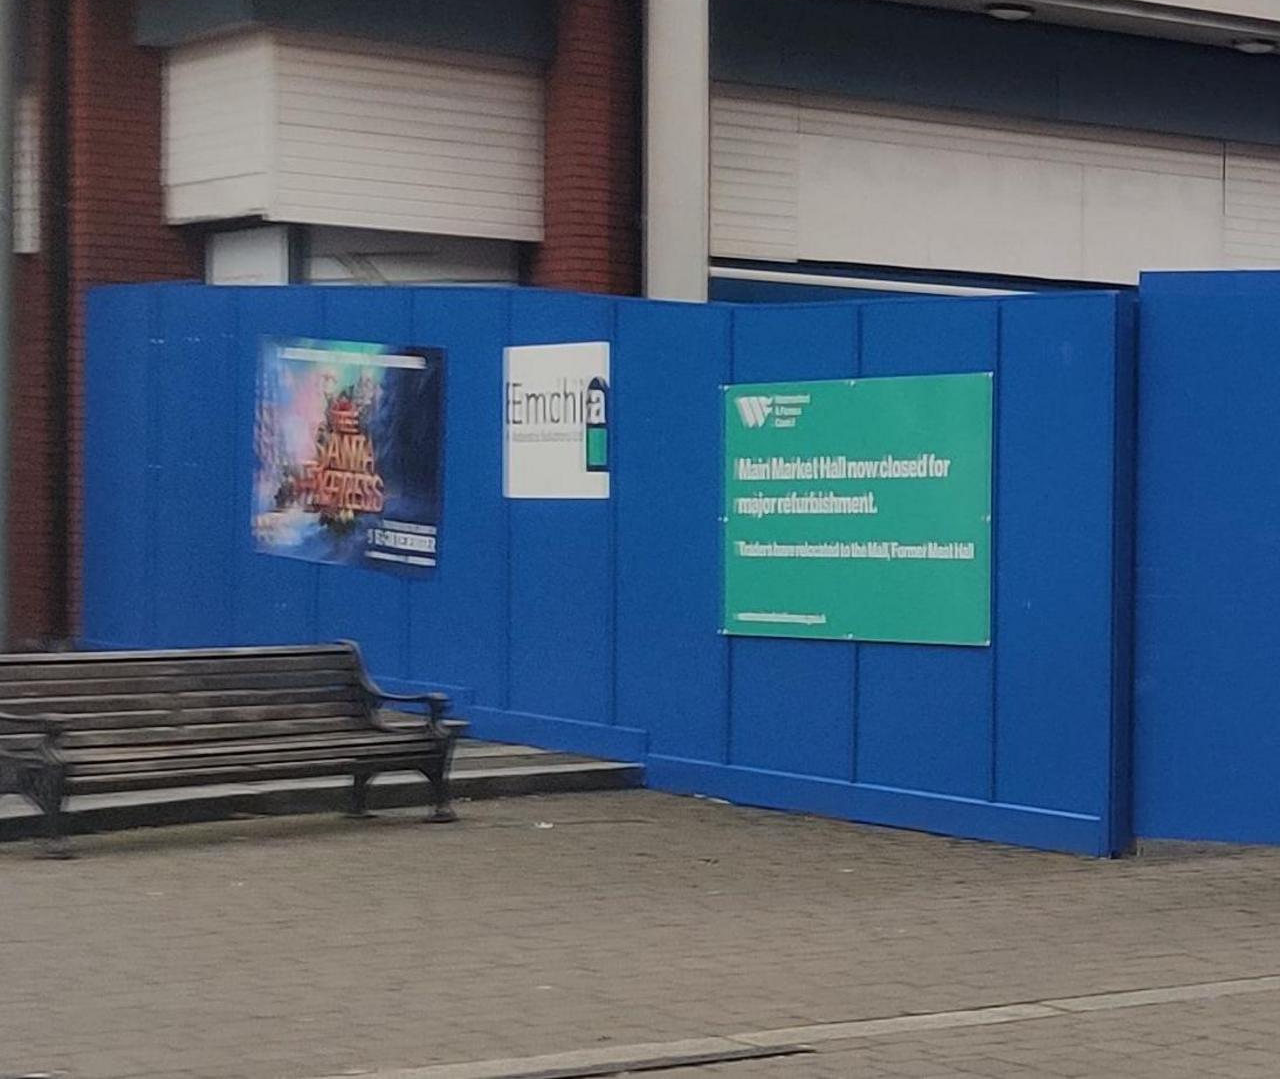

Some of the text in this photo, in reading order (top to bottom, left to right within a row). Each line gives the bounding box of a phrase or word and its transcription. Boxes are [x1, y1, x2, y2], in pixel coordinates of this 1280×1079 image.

[506, 378, 608, 425] Emchia
[735, 453, 951, 481] Main Market Hall now closed for
[736, 491, 879, 518] major refurbishment.
[954, 542, 975, 560] Hall
